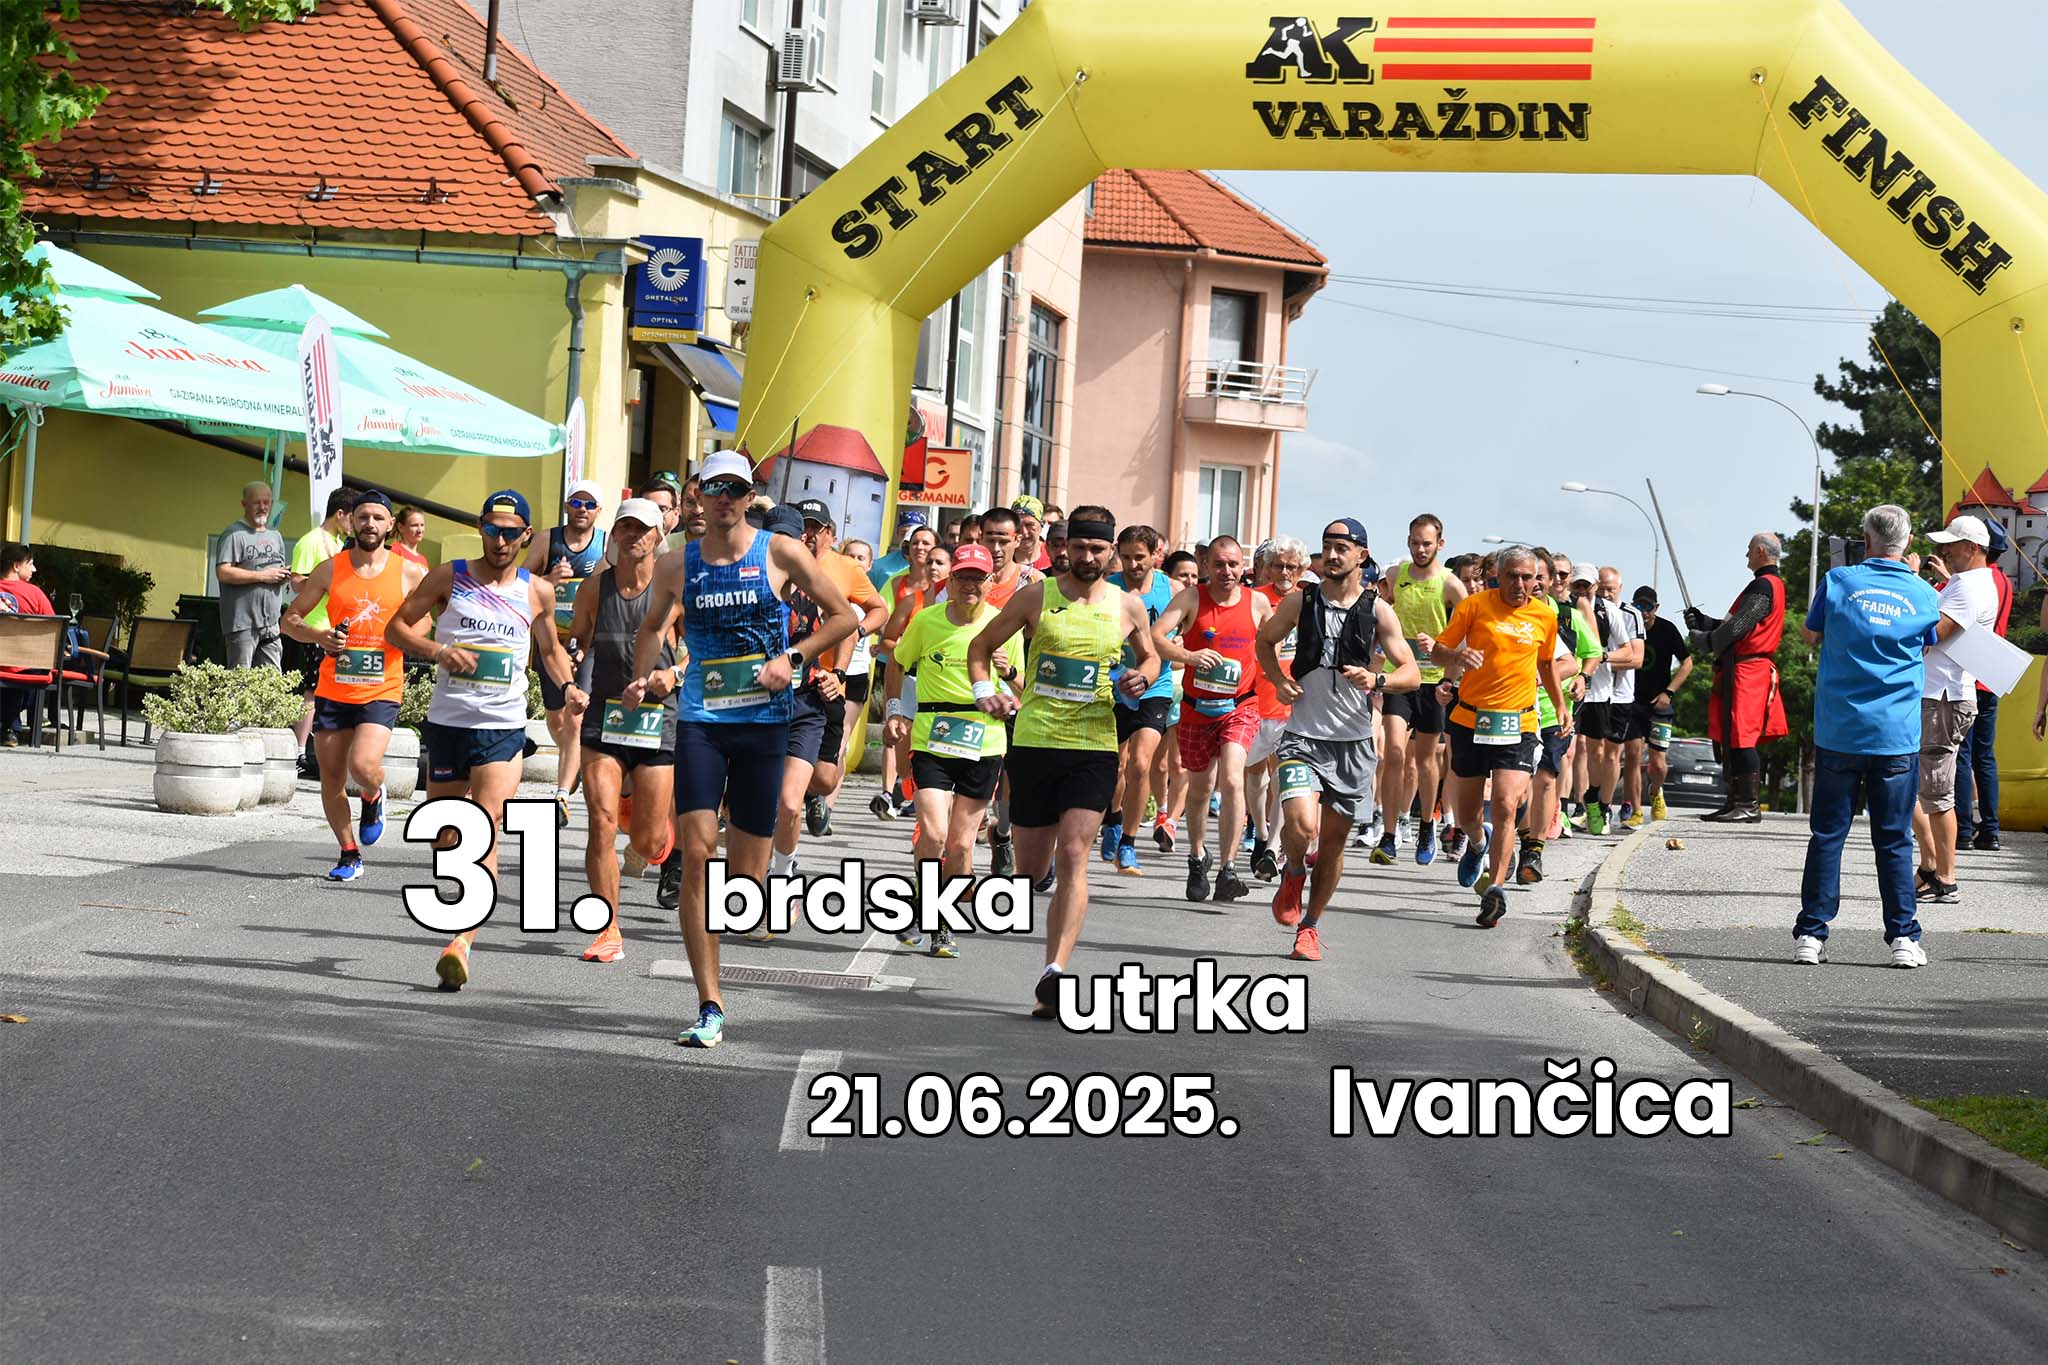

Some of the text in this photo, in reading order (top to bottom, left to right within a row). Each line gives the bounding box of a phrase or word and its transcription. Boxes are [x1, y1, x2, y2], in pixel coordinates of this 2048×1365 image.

[1245, 16, 1375, 85] AK
[1252, 88, 1592, 142] VARAŽDIN
[832, 76, 1044, 260] START
[1788, 75, 2013, 296] FINISH
[650, 316, 679, 325] OPTIKA
[215, 395, 263, 412] PRIRODNA
[898, 490, 966, 505] GERMANIA
[695, 588, 759, 610] CROATIA
[460, 616, 515, 638] CROATIA
[362, 654, 383, 671] 35
[501, 657, 511, 677] 1
[1223, 664, 1240, 681] 11
[1082, 665, 1096, 684] 2
[640, 711, 662, 731] 17
[1501, 715, 1519, 731] 33
[962, 724, 984, 744] 37
[1285, 767, 1308, 783] 23
